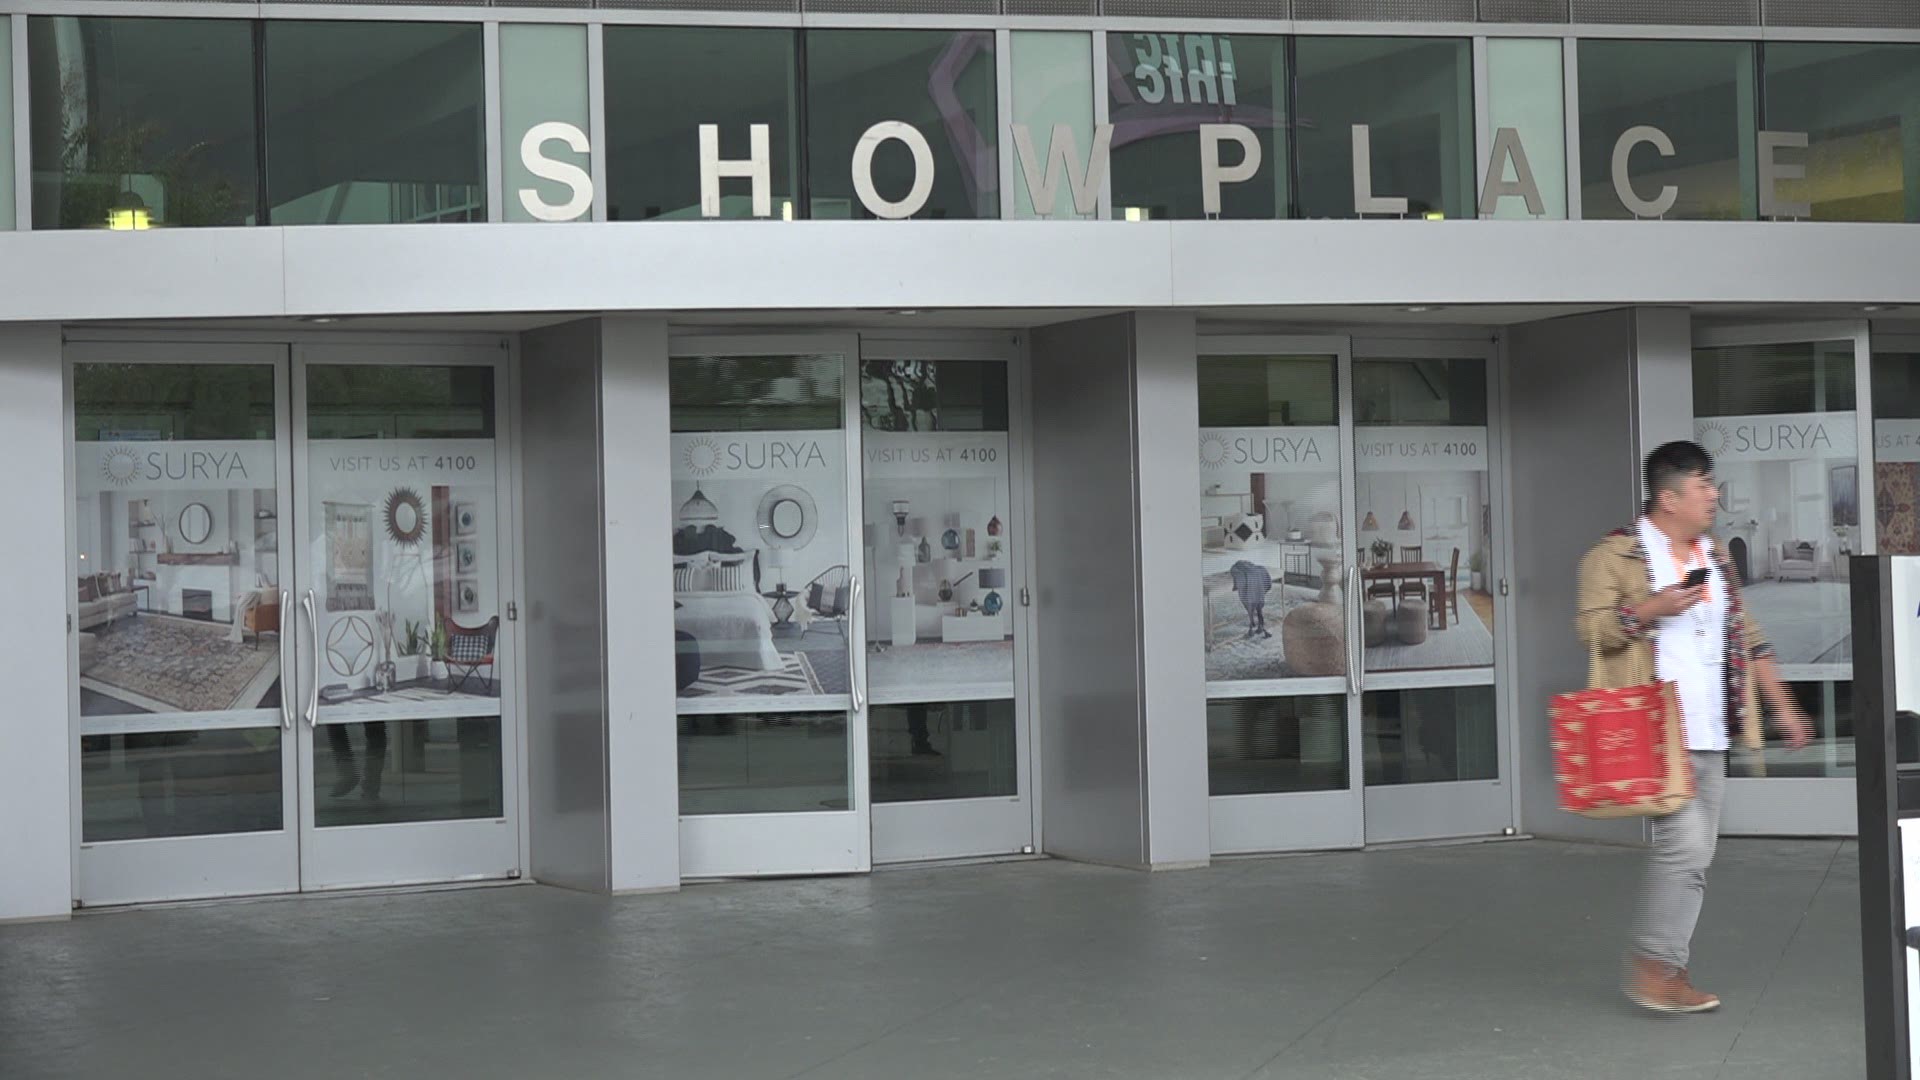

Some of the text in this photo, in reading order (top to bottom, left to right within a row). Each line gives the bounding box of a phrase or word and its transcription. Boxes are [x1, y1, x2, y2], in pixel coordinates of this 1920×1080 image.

[519, 120, 1811, 221] SHOWPLACE
[1234, 437, 1322, 463] SURYA
[1361, 442, 1477, 456] VISIT US AT 4100
[1735, 422, 1831, 453] SURYA
[1895, 434, 1910, 447] AT
[146, 452, 247, 481] SURYA
[330, 455, 476, 471] VISIT US AT 4100
[727, 441, 826, 470] SURYA
[867, 448, 997, 462] VISIT US AT 4100
